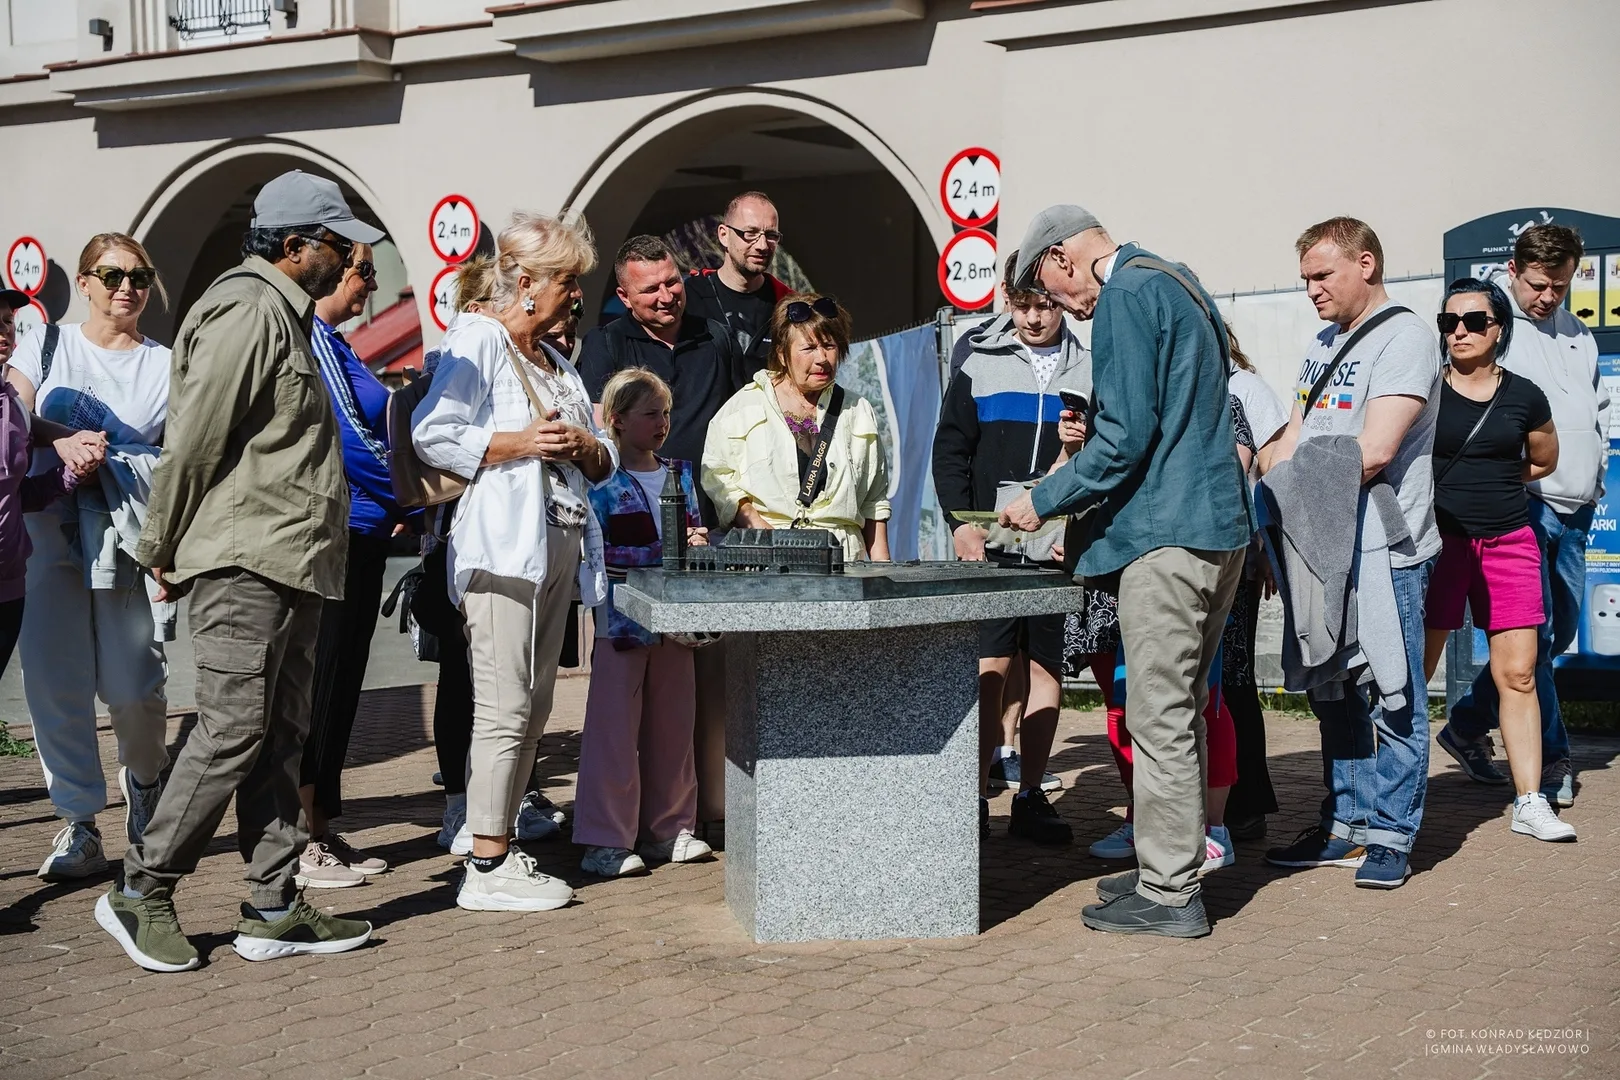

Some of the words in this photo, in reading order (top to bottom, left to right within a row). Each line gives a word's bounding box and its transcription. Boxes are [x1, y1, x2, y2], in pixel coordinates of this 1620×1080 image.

[951, 178, 978, 200] 2,4
[437, 221, 458, 240] 2,4
[1482, 245, 1508, 254] PUNKT
[13, 259, 30, 276] 2,4
[1299, 358, 1361, 388] DIVSE
[802, 469, 818, 498] LAURA
[812, 440, 827, 468] BIAGGI
